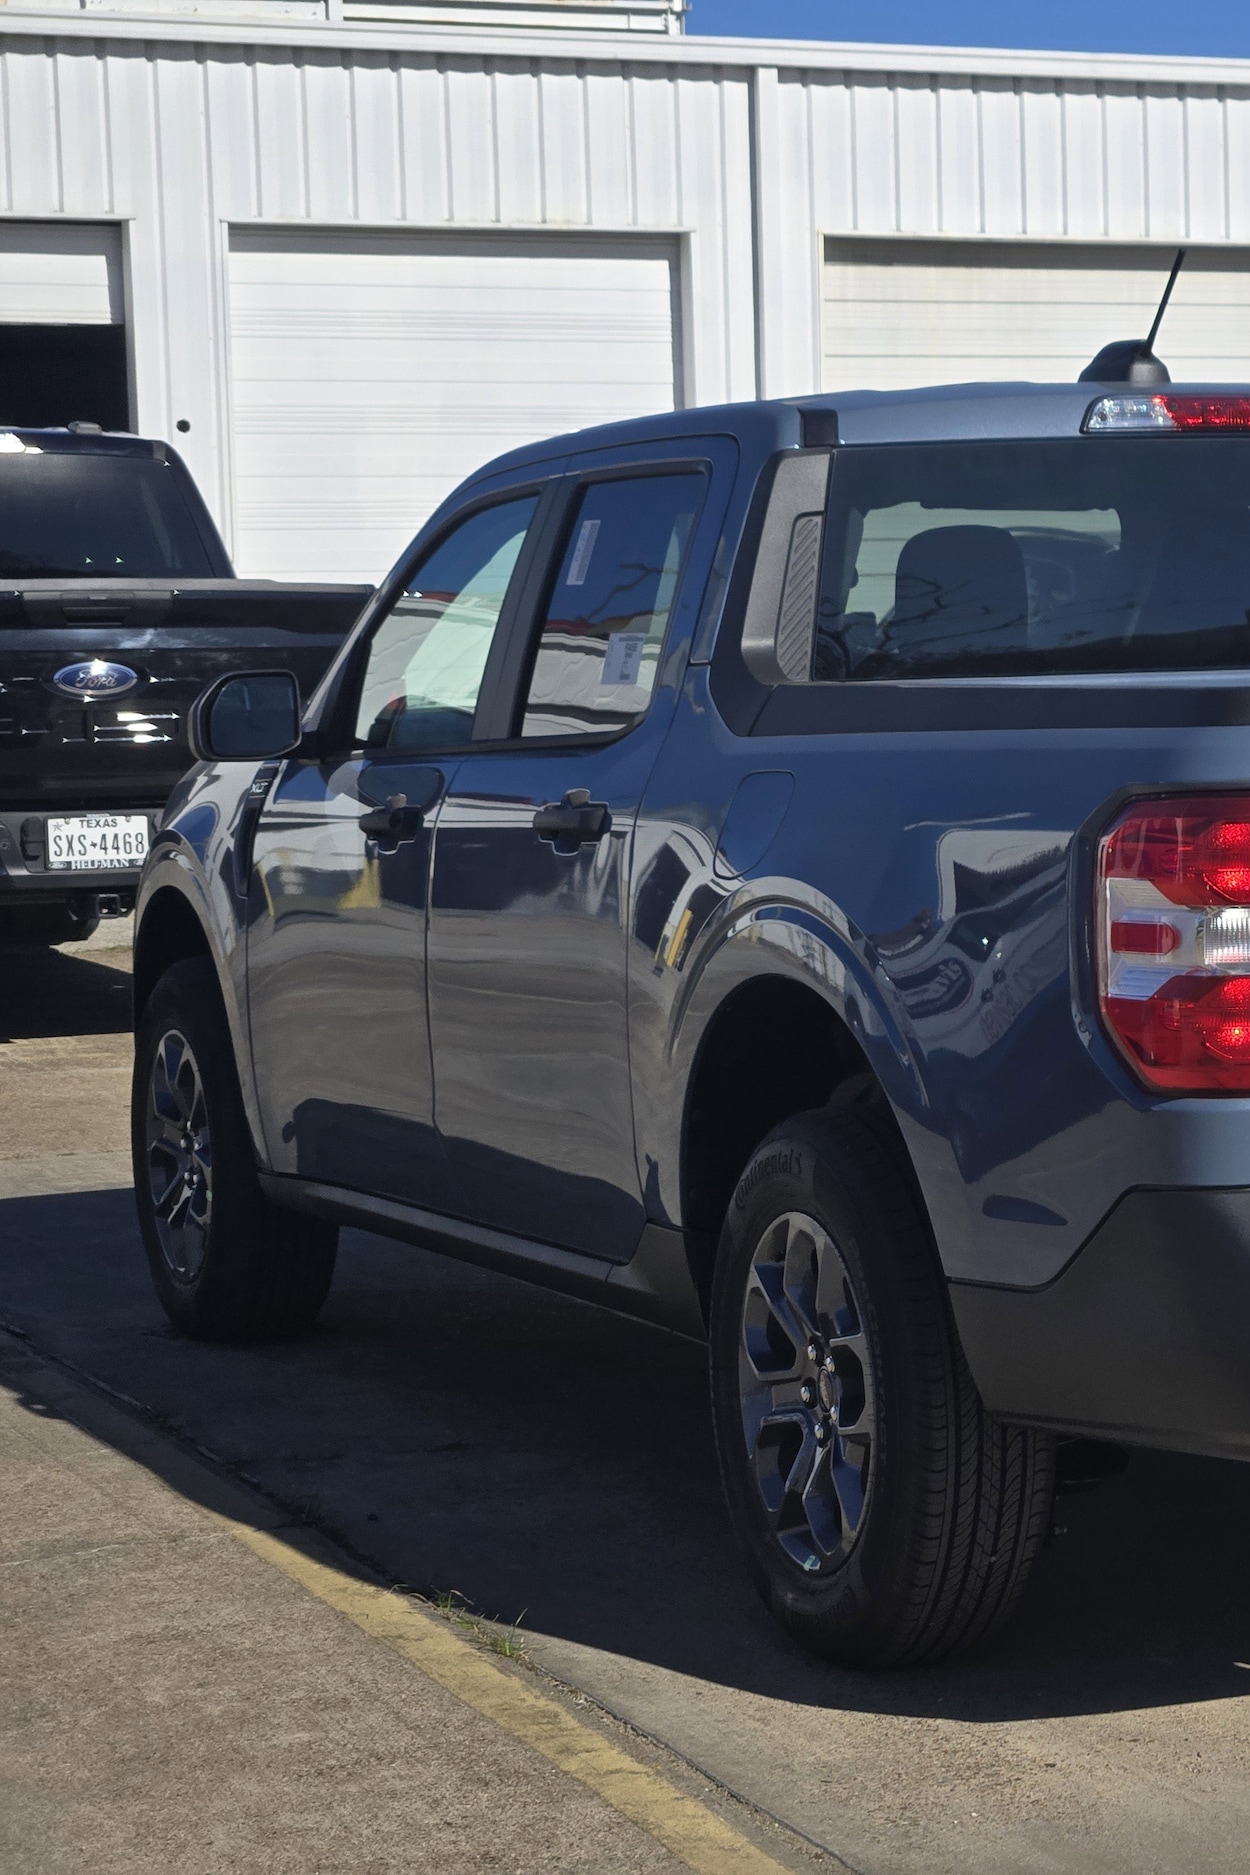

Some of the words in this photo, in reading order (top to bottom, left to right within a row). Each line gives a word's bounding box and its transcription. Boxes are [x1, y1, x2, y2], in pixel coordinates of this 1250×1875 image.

[250, 782, 269, 793] XLT
[79, 818, 118, 828] TEXAS
[53, 834, 87, 857] SXS
[99, 832, 145, 855] 4468
[71, 858, 130, 870] HELFMAN
